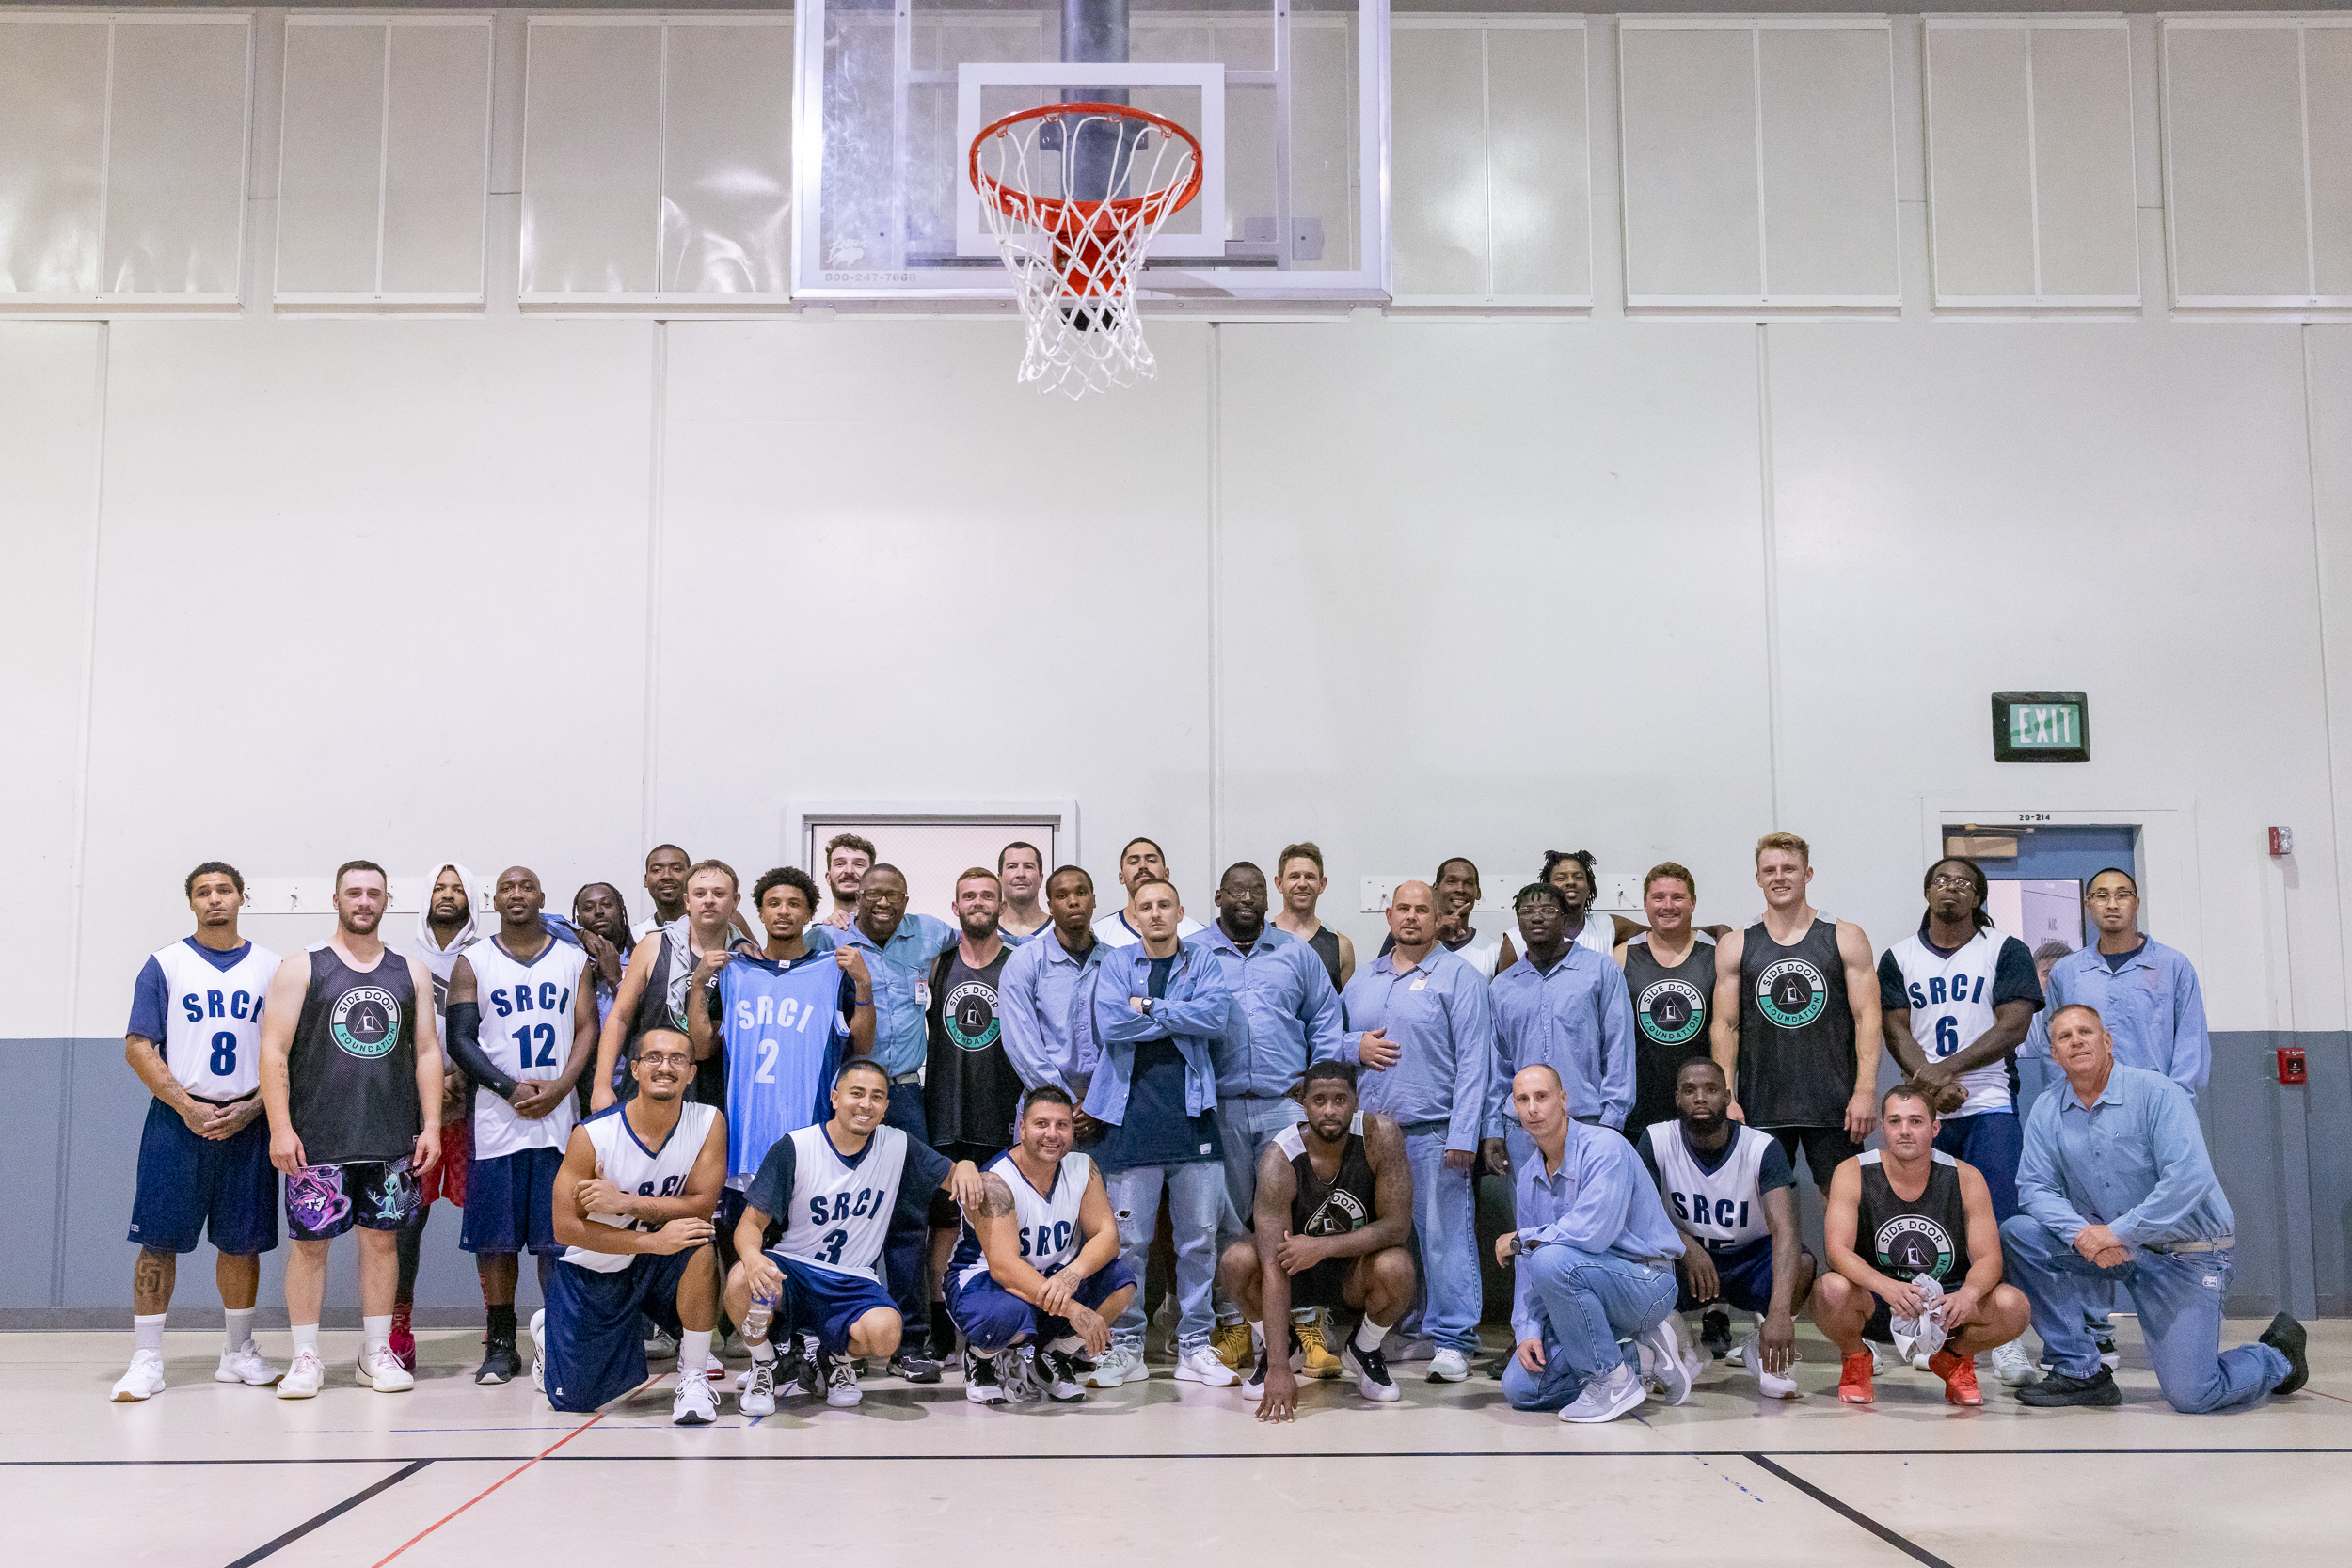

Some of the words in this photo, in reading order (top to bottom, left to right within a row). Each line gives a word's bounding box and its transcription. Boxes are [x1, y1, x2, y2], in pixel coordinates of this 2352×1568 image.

[825, 273, 916, 282] 800-247-7668
[2018, 707, 2071, 744] EXIT
[1762, 965, 1784, 987] SIDE
[1788, 963, 1818, 984] DOOR
[1908, 974, 1985, 1009] SRCI
[183, 990, 263, 1023] SRCI
[339, 992, 360, 1013] SIDE
[365, 991, 394, 1013] DOOR
[490, 981, 570, 1018] SRCI
[949, 987, 969, 1007] SIDE
[973, 986, 999, 1009] DOOR
[1644, 985, 1664, 1004] SIDE
[1668, 983, 1697, 1002] DOOR
[1766, 997, 1820, 1022] FOUNDATION
[736, 995, 814, 1033] SRCI
[1645, 1015, 1699, 1039] FOUNDATION
[341, 1027, 395, 1053] FOUNDATION
[512, 1022, 557, 1069] 12
[951, 1022, 998, 1045] FOUNDATION
[1935, 1015, 1959, 1058] 6
[209, 1031, 237, 1077] 8
[755, 1038, 780, 1084] 2
[809, 1187, 885, 1226] SRCI
[1331, 1194, 1356, 1212] OOR
[1670, 1191, 1749, 1228] SRCI
[814, 1228, 849, 1266] 3
[1881, 1222, 1905, 1244] SIDE
[1909, 1220, 1943, 1243] DOOR
